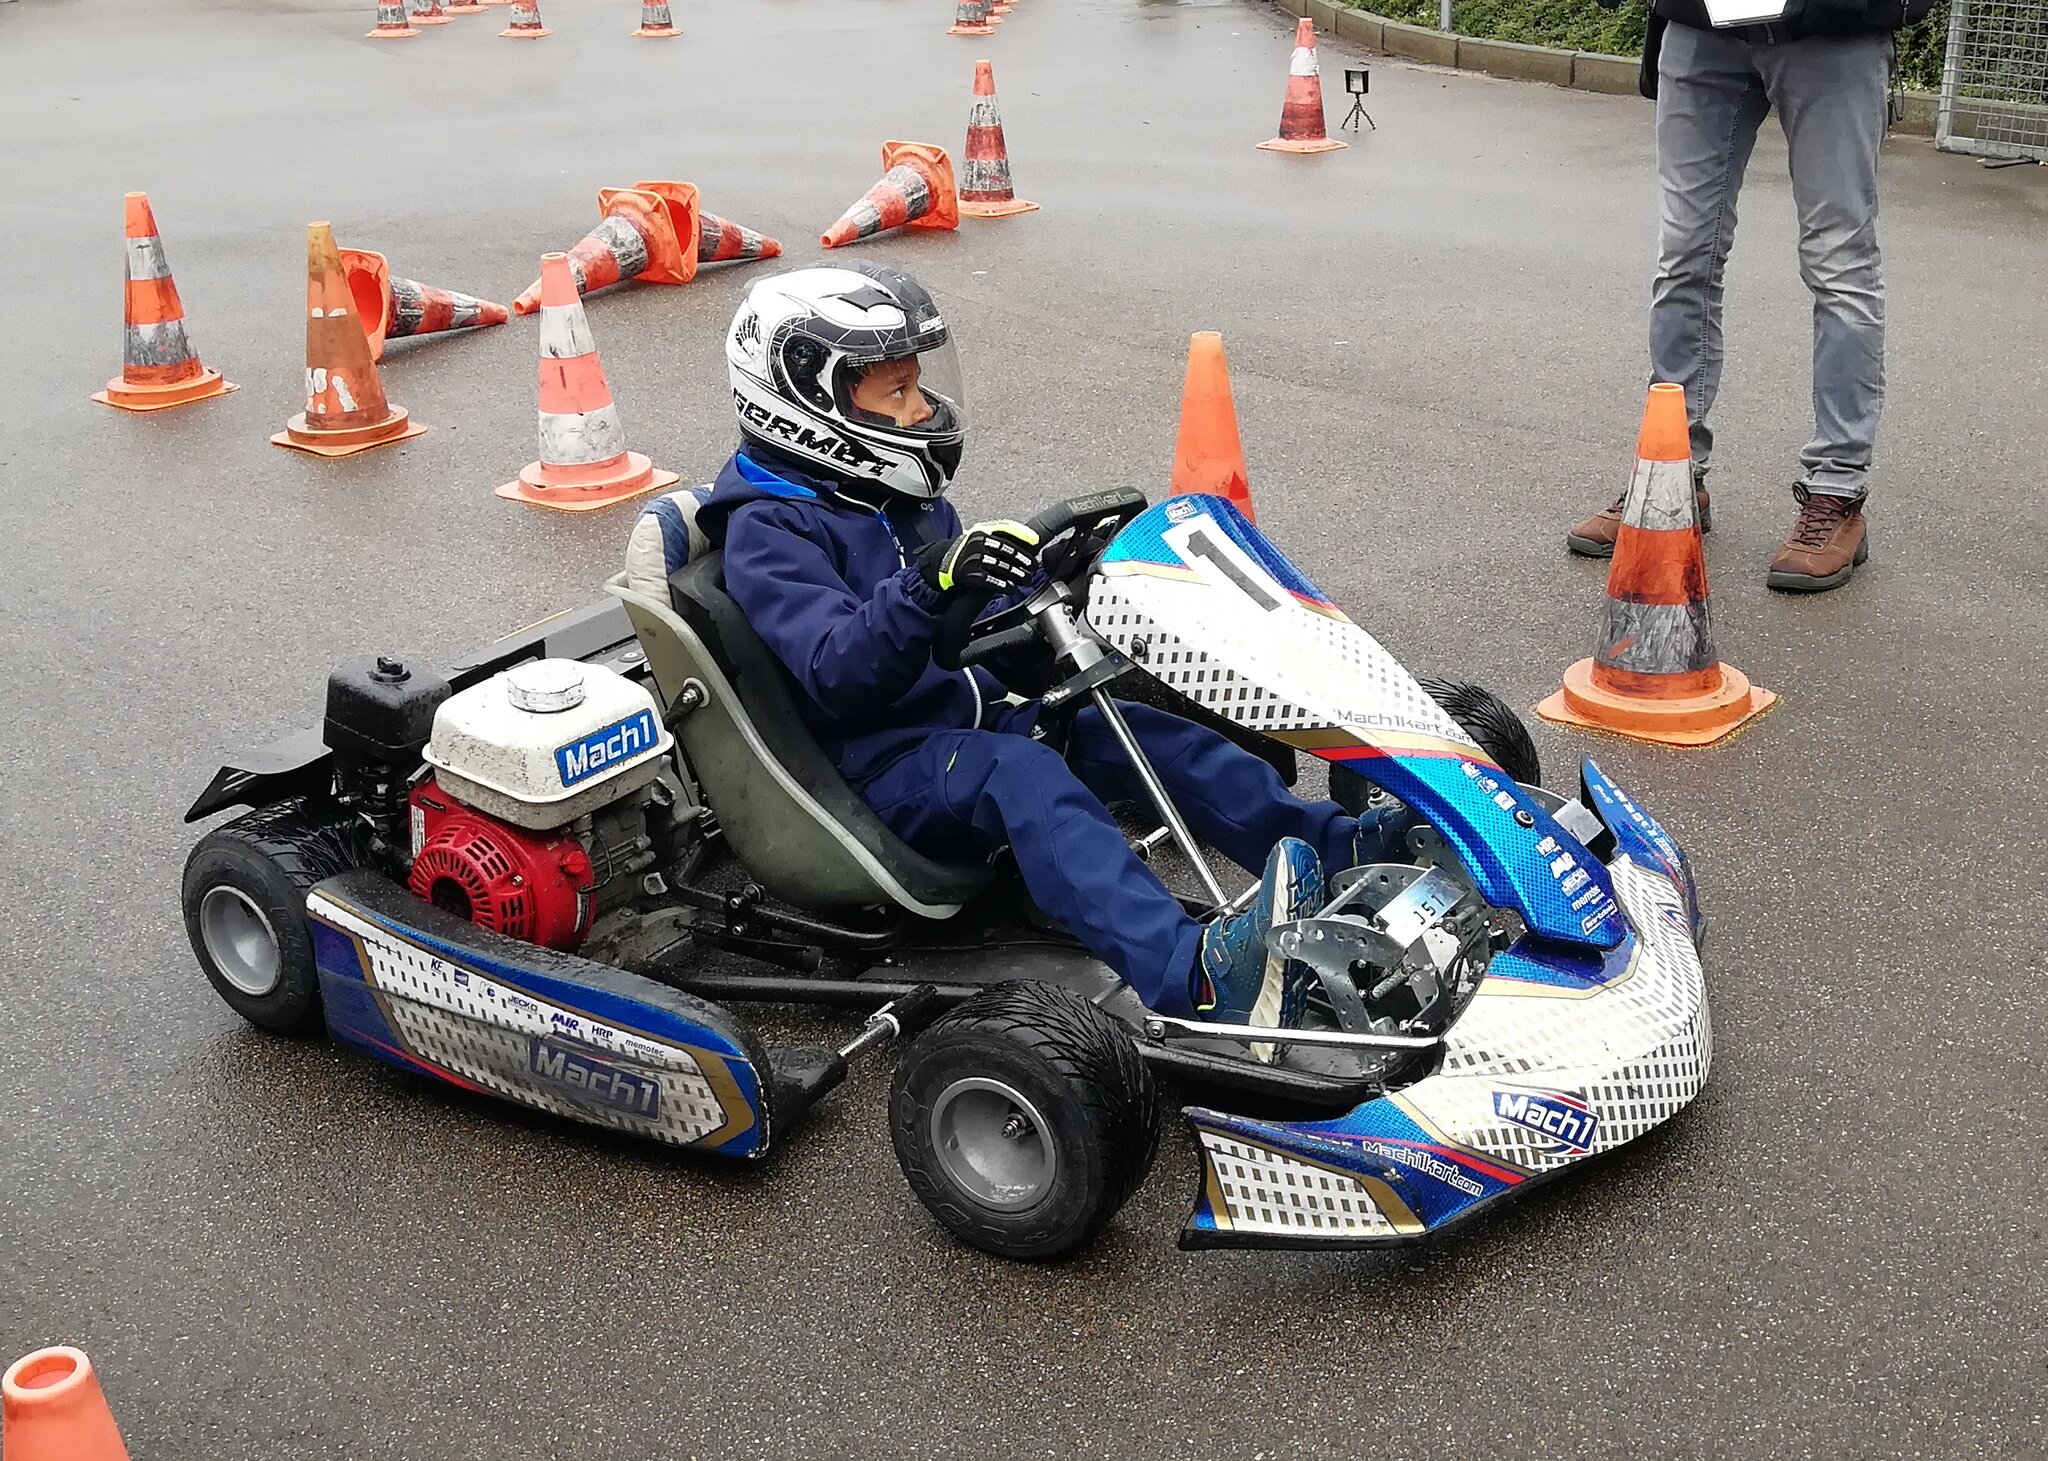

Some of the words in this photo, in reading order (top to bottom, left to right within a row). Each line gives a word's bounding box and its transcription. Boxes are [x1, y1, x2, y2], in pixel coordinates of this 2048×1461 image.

[1187, 529, 1282, 613] 1
[565, 714, 651, 780] Mach1
[591, 1024, 613, 1039] HRP
[625, 1039, 665, 1057] memotec
[536, 1044, 654, 1112] Mach1
[1498, 1092, 1595, 1145] Mach1
[1362, 1140, 1484, 1197] Mach1kart.com
